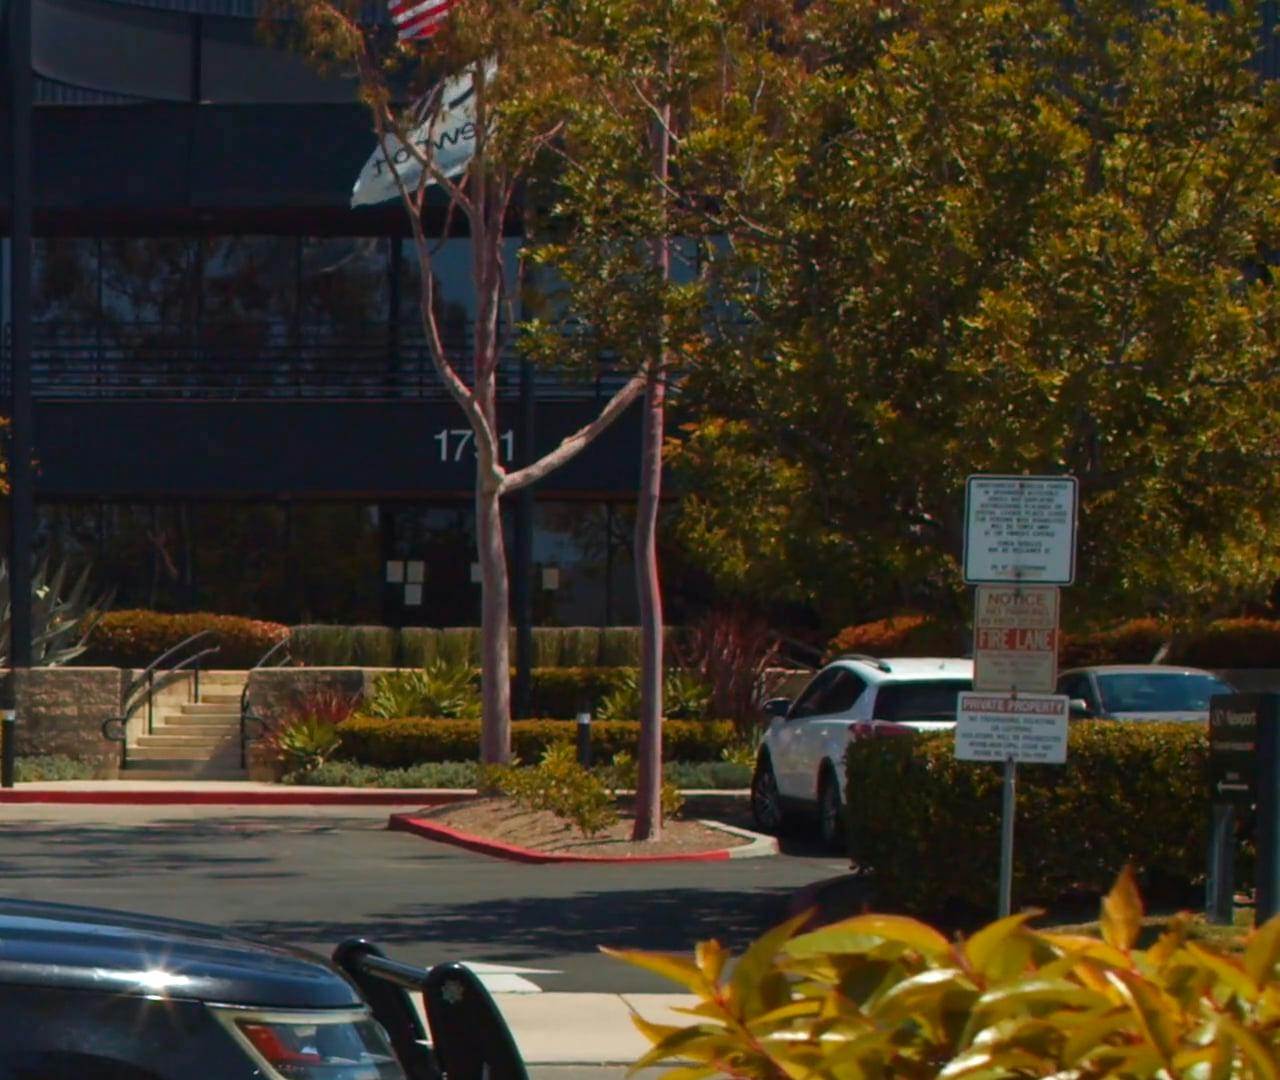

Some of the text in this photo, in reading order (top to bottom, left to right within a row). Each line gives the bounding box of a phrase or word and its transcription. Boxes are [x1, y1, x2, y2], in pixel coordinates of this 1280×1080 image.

[433, 428, 514, 462] 171
[987, 592, 1044, 606] NOTICE
[979, 629, 1053, 650] FIRE LANE
[964, 697, 1063, 715] PRIVATE PROPERTY
